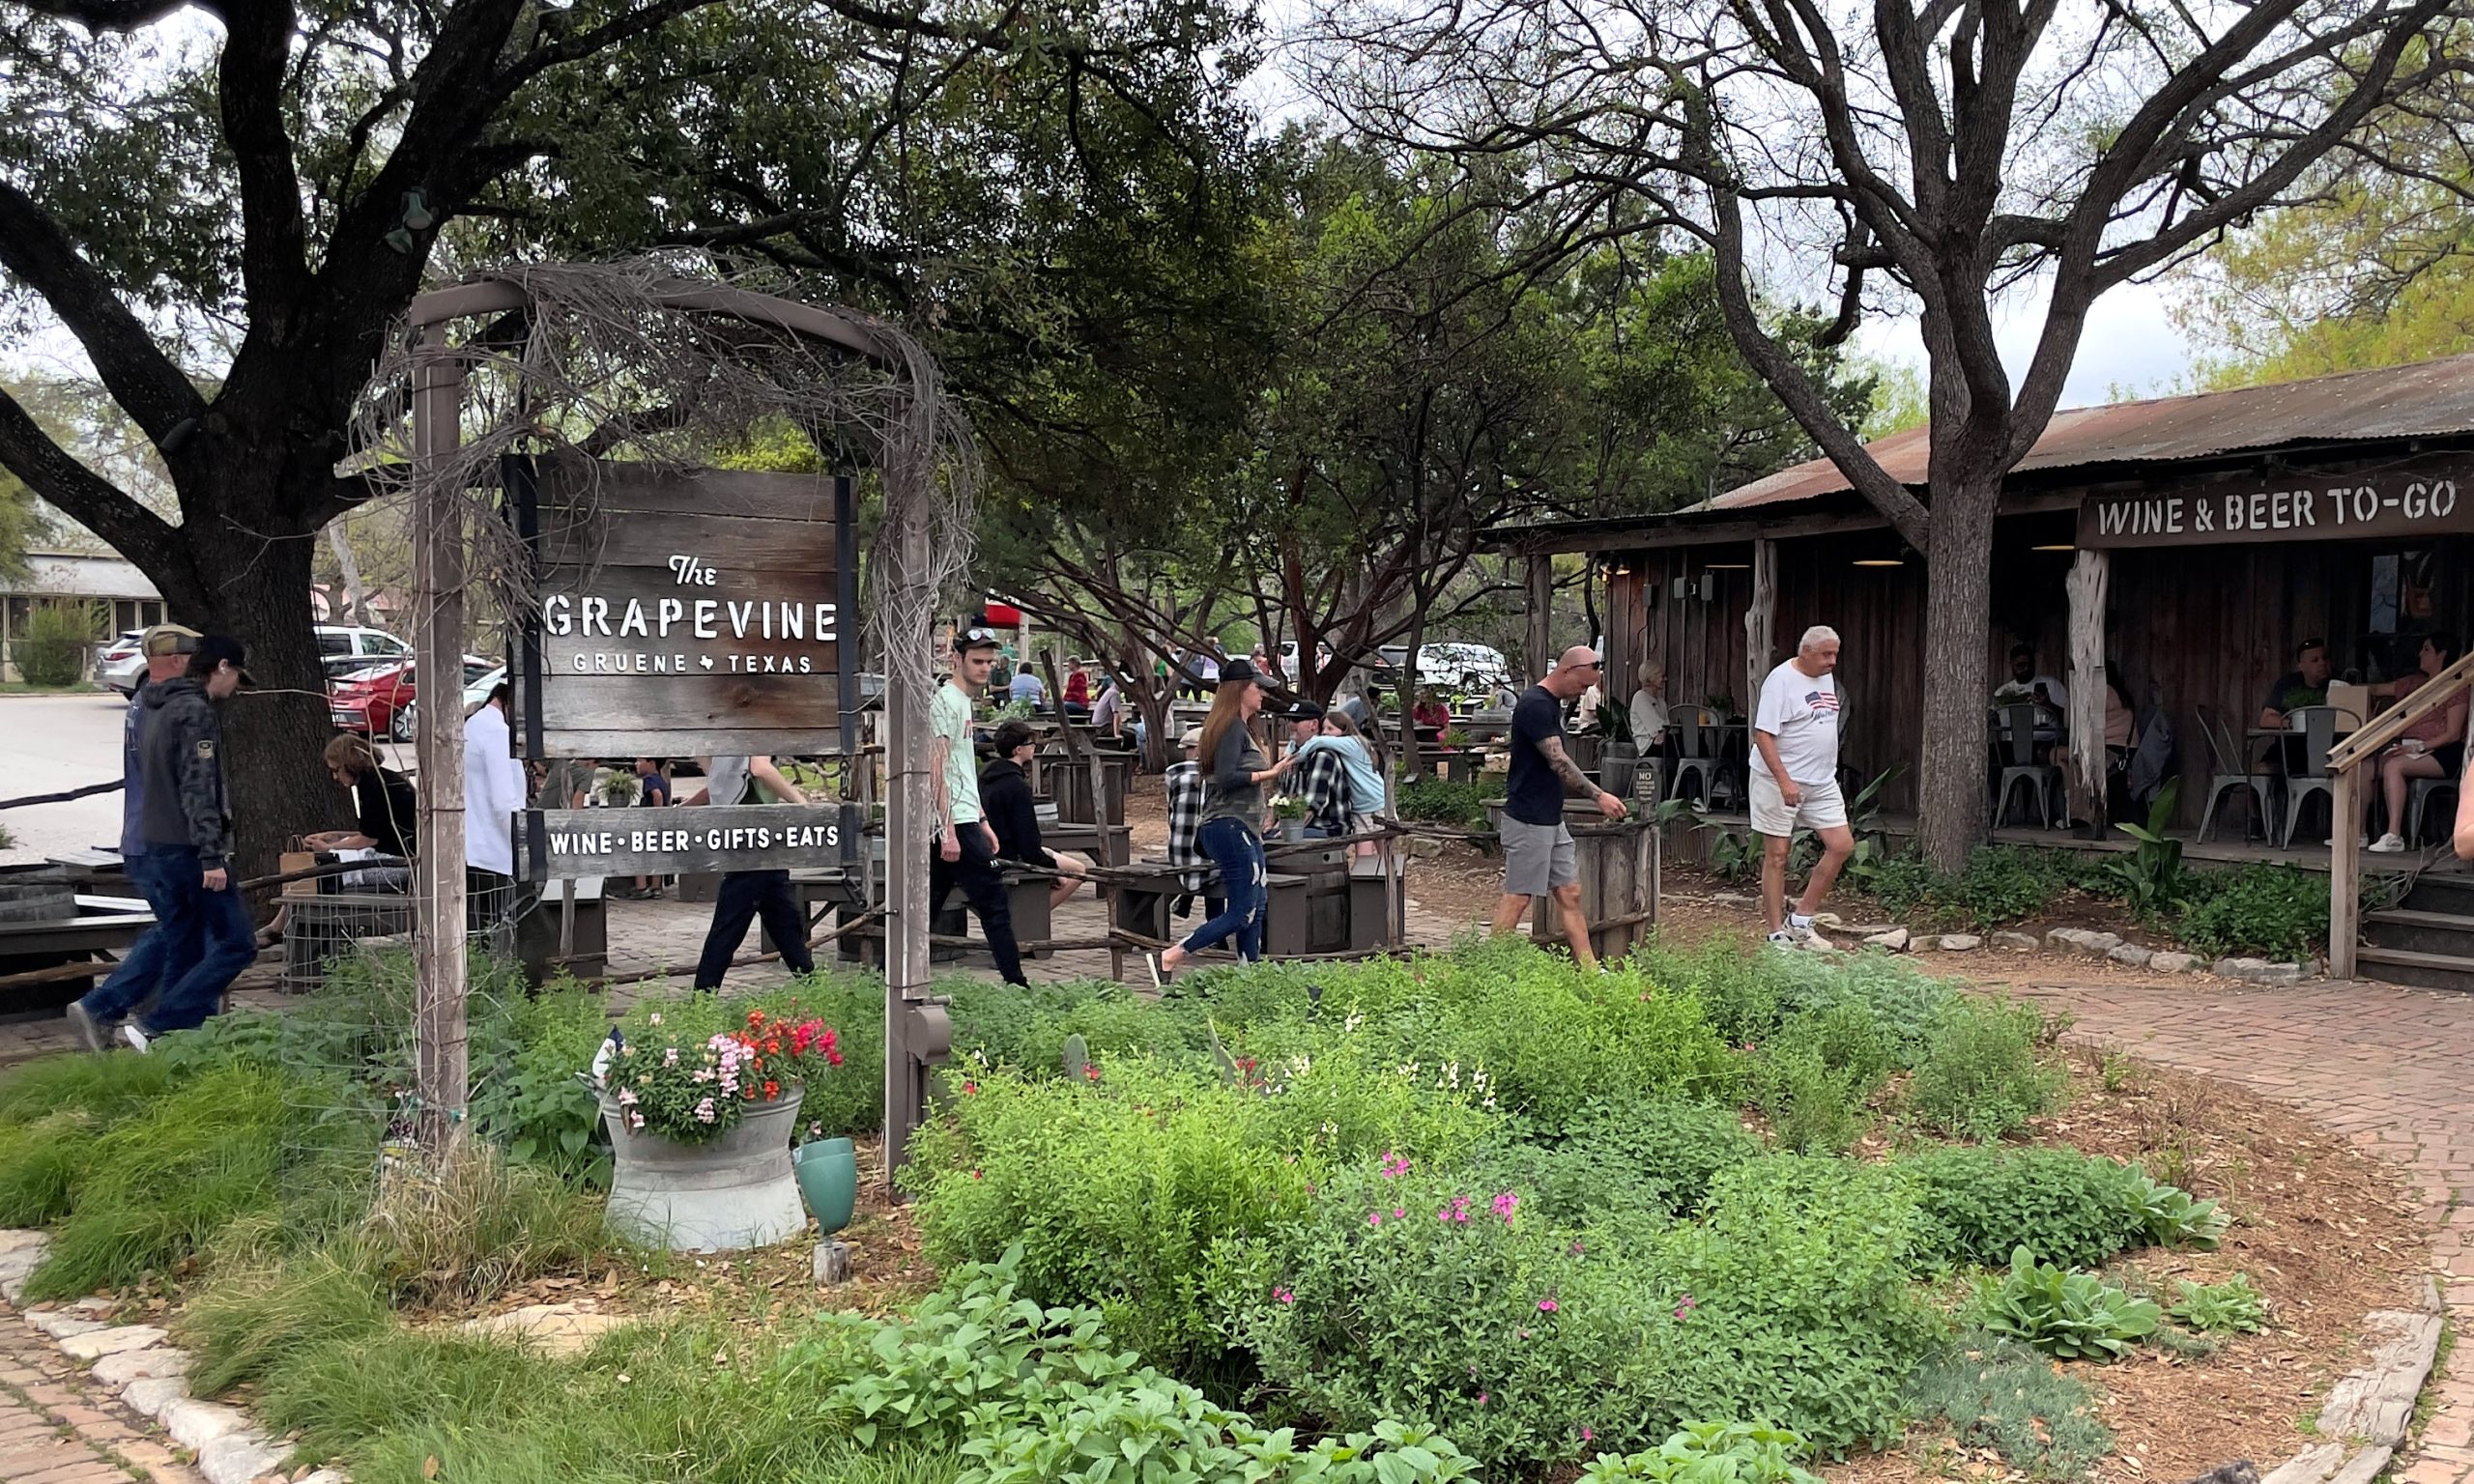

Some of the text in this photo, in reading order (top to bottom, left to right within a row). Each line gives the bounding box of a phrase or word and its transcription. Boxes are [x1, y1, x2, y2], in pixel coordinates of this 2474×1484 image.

[2099, 480, 2456, 535] WINE & BEER TO-GO
[668, 555, 717, 585] The
[543, 594, 837, 642] GRAPEVINE
[573, 653, 812, 673] GRUENE TEXAS
[1638, 772, 1652, 781] NO
[550, 825, 839, 855] WINE BEER GIFTS EATS
